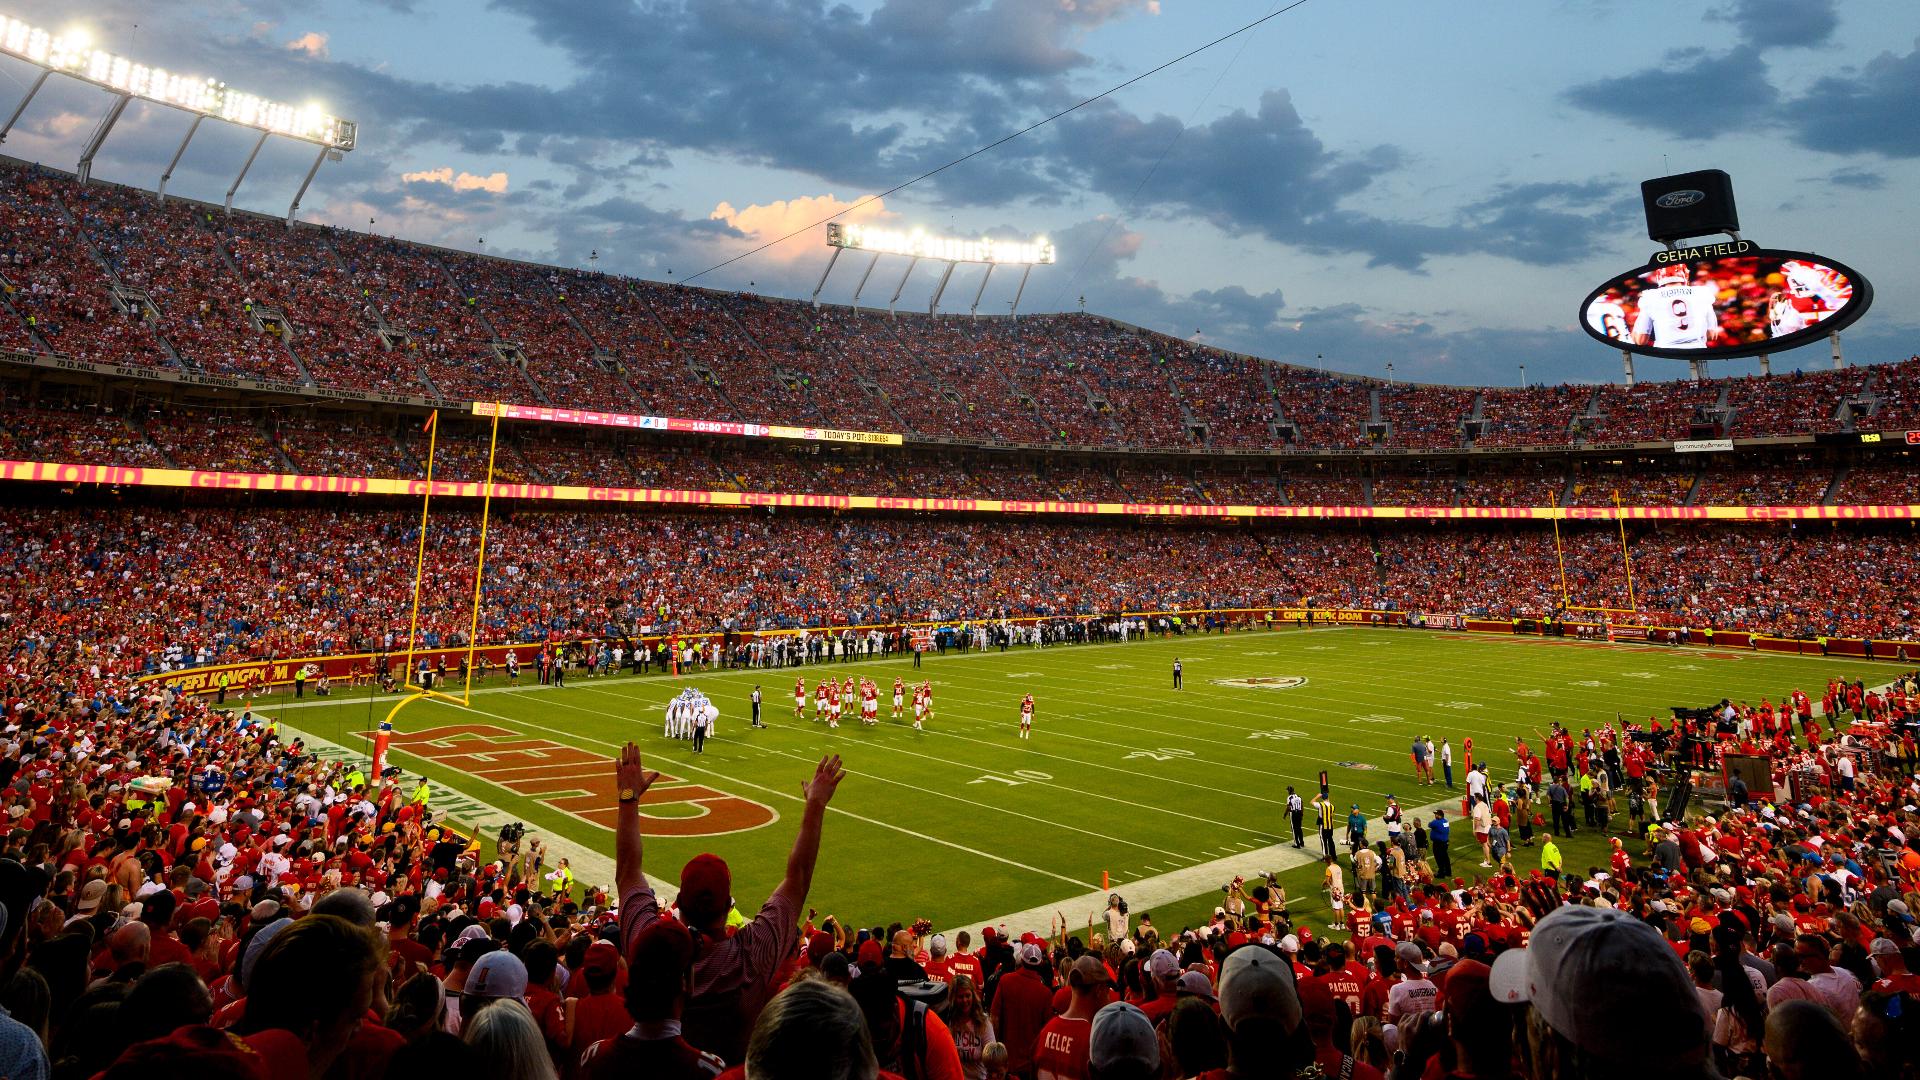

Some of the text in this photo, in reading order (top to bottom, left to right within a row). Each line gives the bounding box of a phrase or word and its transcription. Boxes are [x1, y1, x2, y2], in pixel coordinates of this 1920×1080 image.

[1665, 191, 1697, 206] Ford
[1656, 241, 1749, 263] GEHA FIELD
[0, 351, 37, 364] CHERRY
[77, 362, 97, 372] HILL
[136, 370, 161, 379] STILL
[198, 376, 239, 387] BURRUSS
[274, 385, 301, 394] OKOYE
[334, 390, 366, 400] THOMAS
[823, 430, 851, 440] TODAY'S
[191, 471, 268, 489] GET
[408, 480, 471, 497] GET
[588, 486, 641, 502] GET
[740, 492, 787, 506] GET
[876, 497, 920, 510] GET
[1001, 500, 1042, 513] GET
[1122, 504, 1167, 515] GET
[1255, 506, 1301, 517] GET
[1404, 507, 1456, 518] GET
[1565, 506, 1619, 519] GET
[1745, 506, 1811, 519] GET
[1283, 611, 1311, 621] CHIEF
[208, 665, 289, 688] KNGDM
[1130, 747, 1196, 761] 20
[978, 769, 1054, 787] 10
[1357, 923, 1371, 938] 52
[1328, 982, 1360, 993] PACHECO
[1044, 1031, 1074, 1055] KELCE
